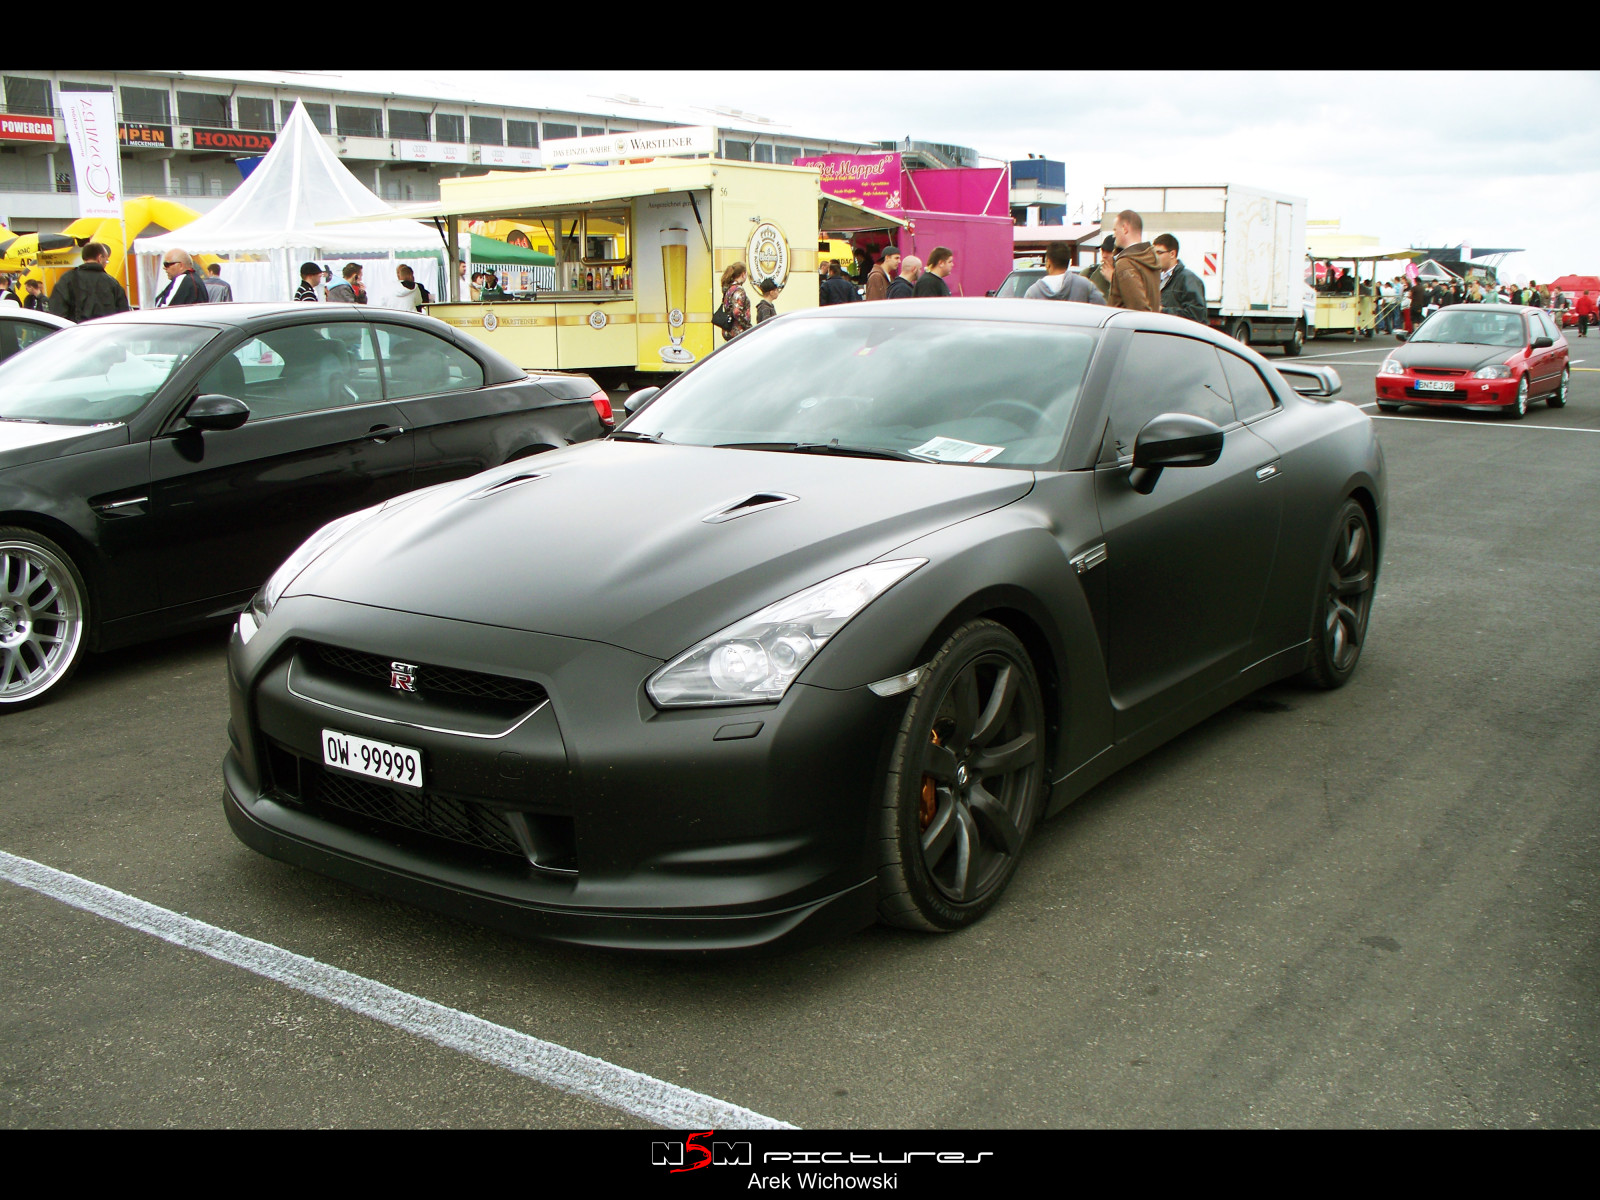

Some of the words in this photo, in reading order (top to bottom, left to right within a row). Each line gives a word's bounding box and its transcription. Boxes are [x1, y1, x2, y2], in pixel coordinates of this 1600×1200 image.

[2, 120, 53, 135] POWERCAR
[194, 132, 274, 149] HONDA
[566, 148, 588, 156] EINZIG
[589, 145, 611, 154] WAHRE
[719, 187, 728, 197] 56
[1419, 381, 1429, 389] BN
[360, 744, 417, 782] 99999
